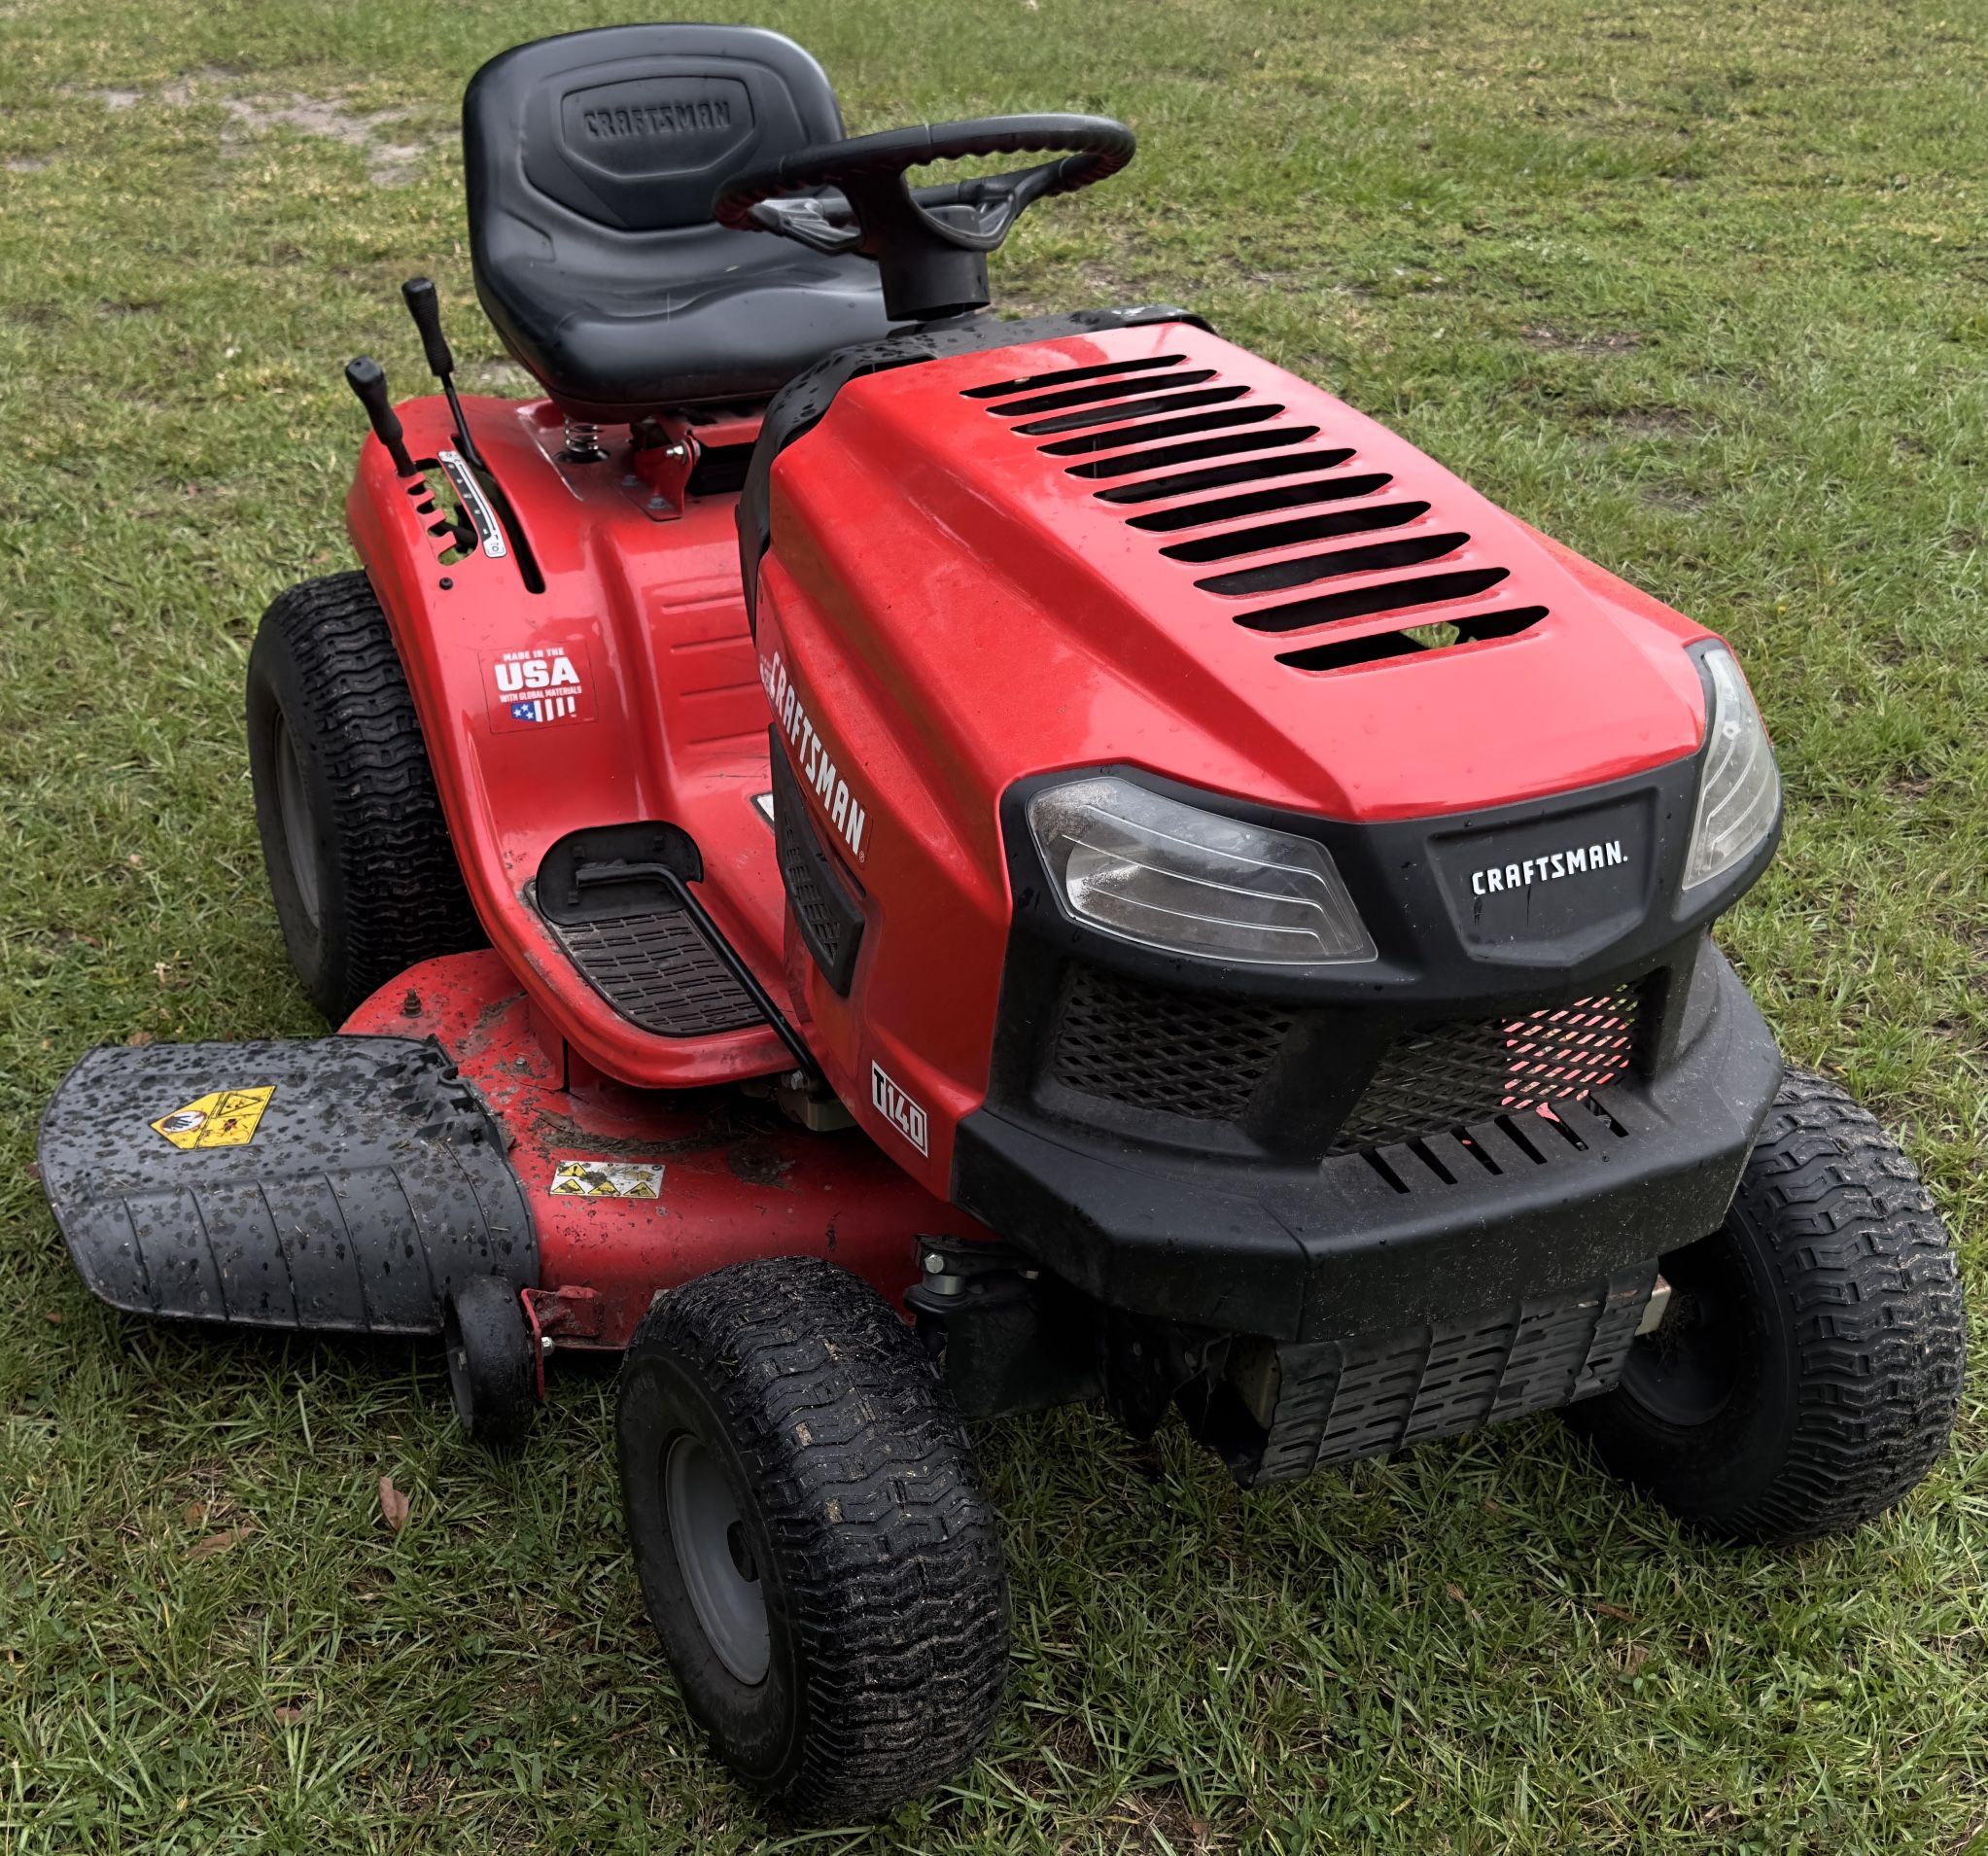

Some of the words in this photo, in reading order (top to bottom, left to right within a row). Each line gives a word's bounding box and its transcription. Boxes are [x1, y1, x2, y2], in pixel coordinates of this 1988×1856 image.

[584, 101, 730, 138] CRAFTSMAN
[503, 650, 531, 661] MADE
[533, 648, 544, 658] IN
[545, 647, 564, 656] THE
[494, 656, 580, 691] USA
[499, 693, 518, 703] WITH
[518, 690, 544, 701] GLOBAL
[544, 685, 582, 697] MATERIALS
[873, 1067, 924, 1148] T140
